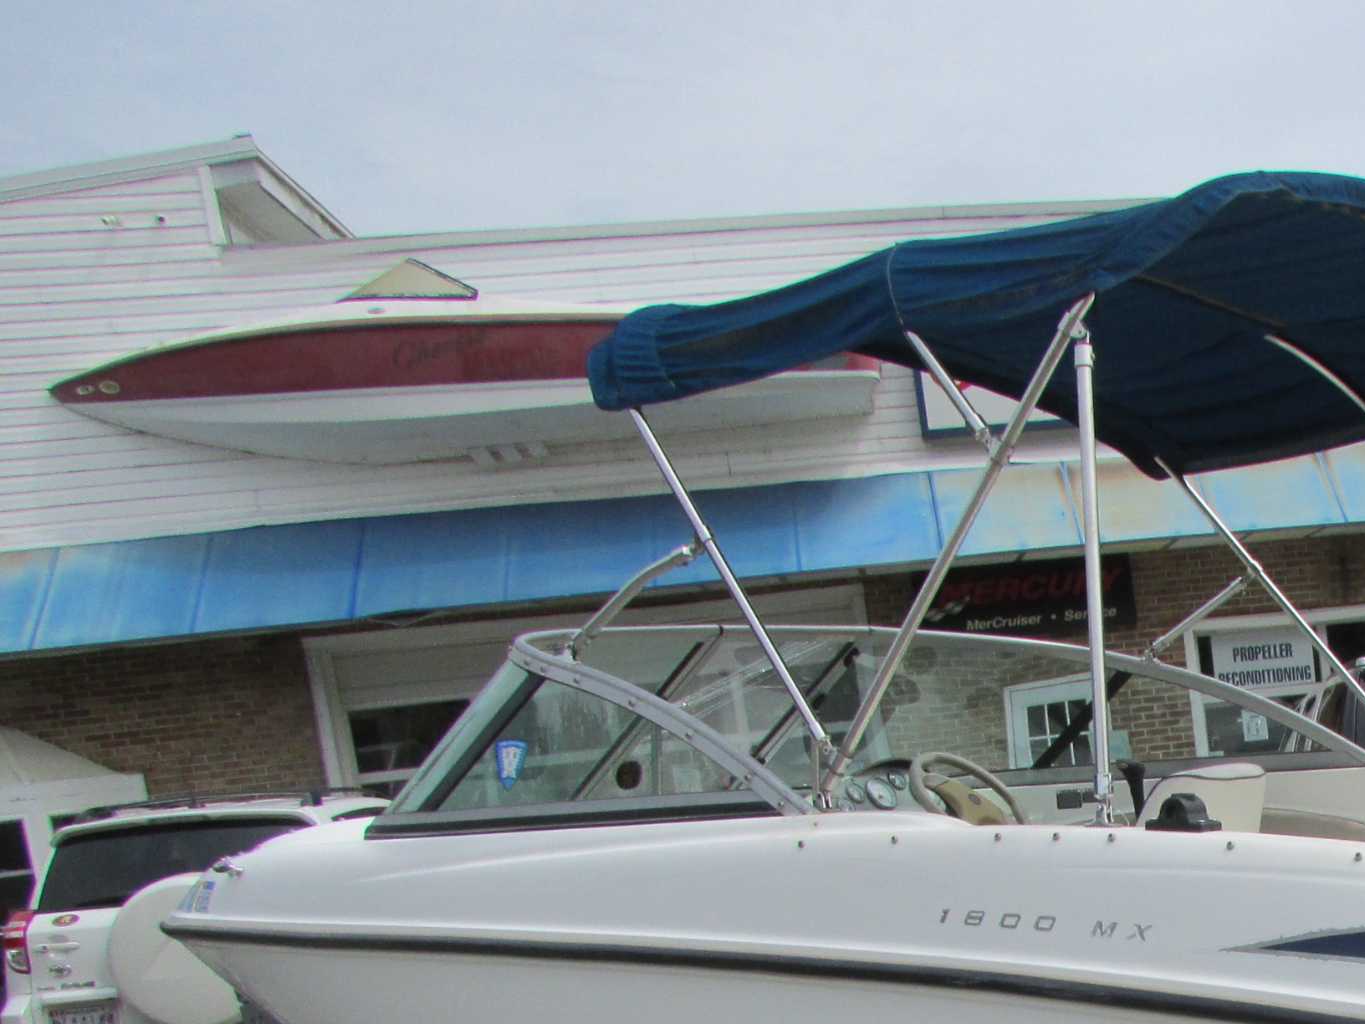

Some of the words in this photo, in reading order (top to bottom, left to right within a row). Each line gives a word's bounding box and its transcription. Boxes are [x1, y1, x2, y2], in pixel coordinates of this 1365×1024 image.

[966, 613, 1042, 631] MerCruiser
[1063, 606, 1117, 622] Serce
[1232, 642, 1294, 663] PROPELLER
[939, 908, 1056, 932] 1800
[1090, 919, 1153, 941] MX
